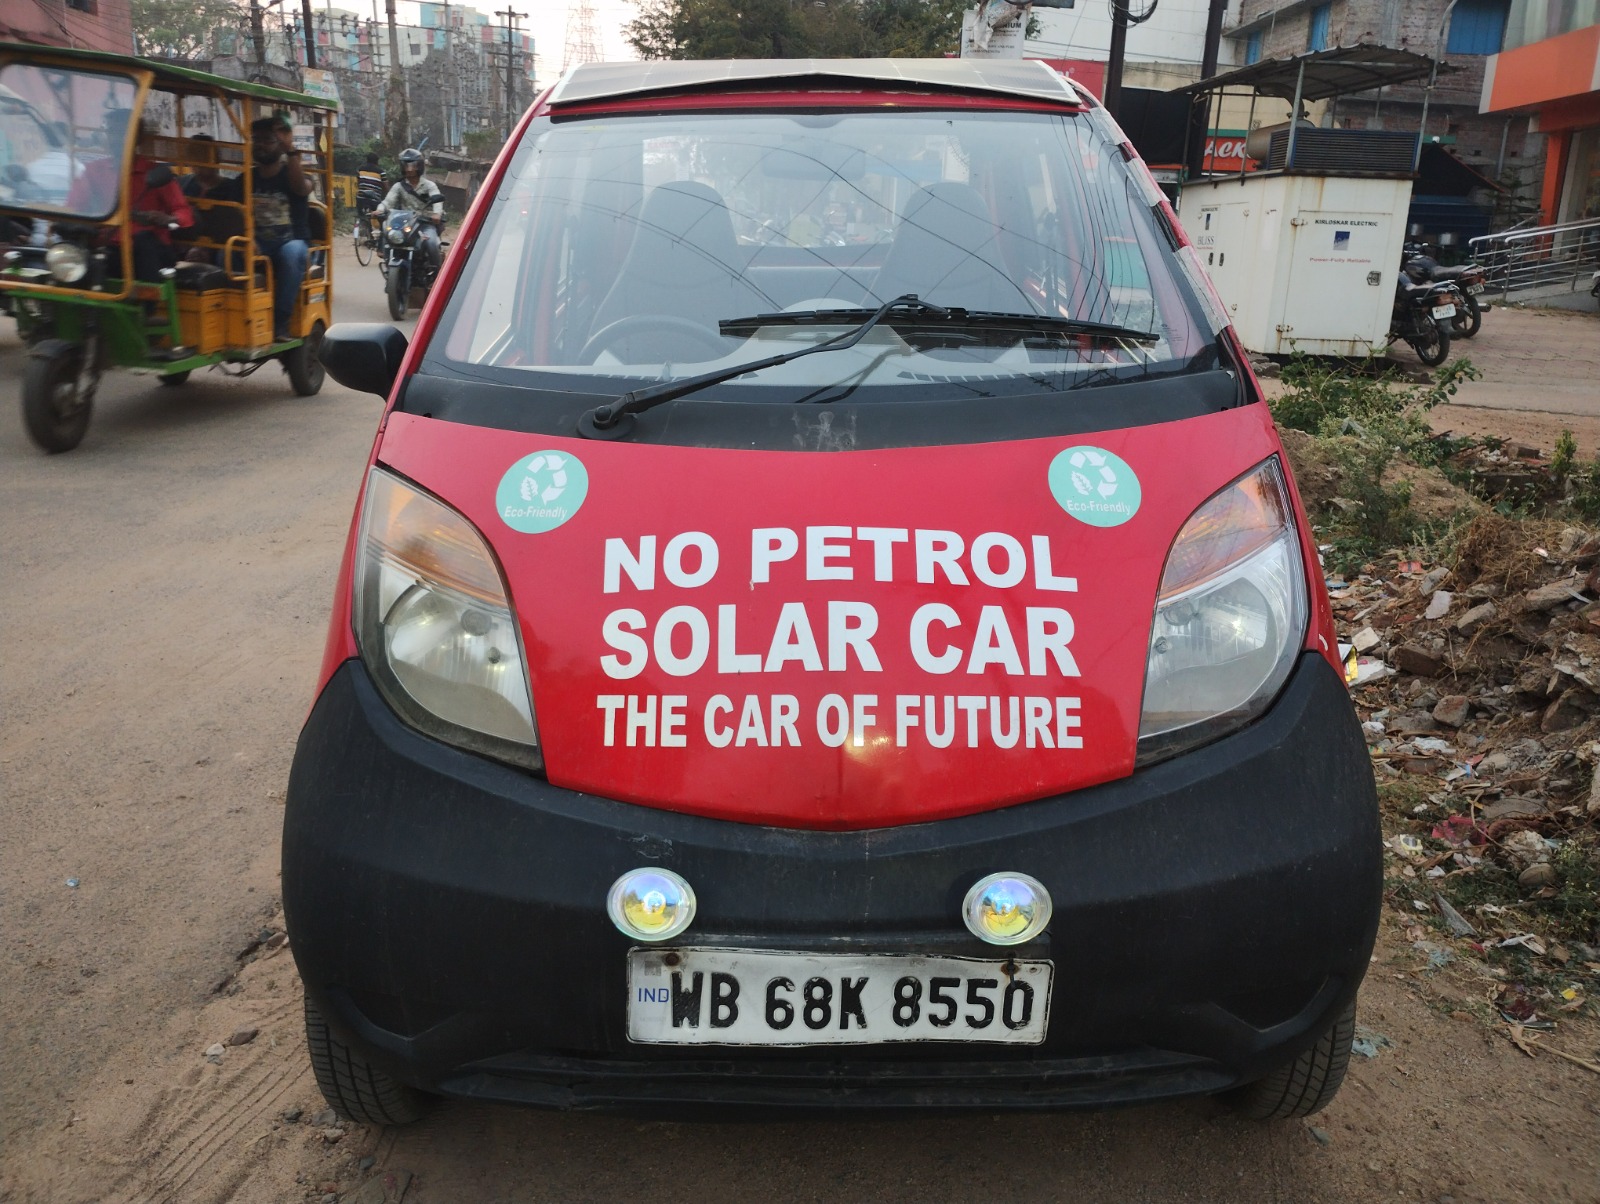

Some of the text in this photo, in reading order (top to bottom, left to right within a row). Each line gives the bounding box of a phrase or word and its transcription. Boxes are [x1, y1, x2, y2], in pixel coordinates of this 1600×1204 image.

[1204, 140, 1252, 159] ACK
[1197, 235, 1215, 246] BLISS
[504, 505, 568, 521] Eco-Friendly
[1066, 499, 1131, 516] Eco-Friendly
[603, 525, 1078, 594] NO PETROL
[600, 600, 1082, 680] SOLAR CAR
[596, 693, 1083, 749] THE CAR OF FUTURE
[638, 971, 1034, 1031] IND WB 68K 8550
